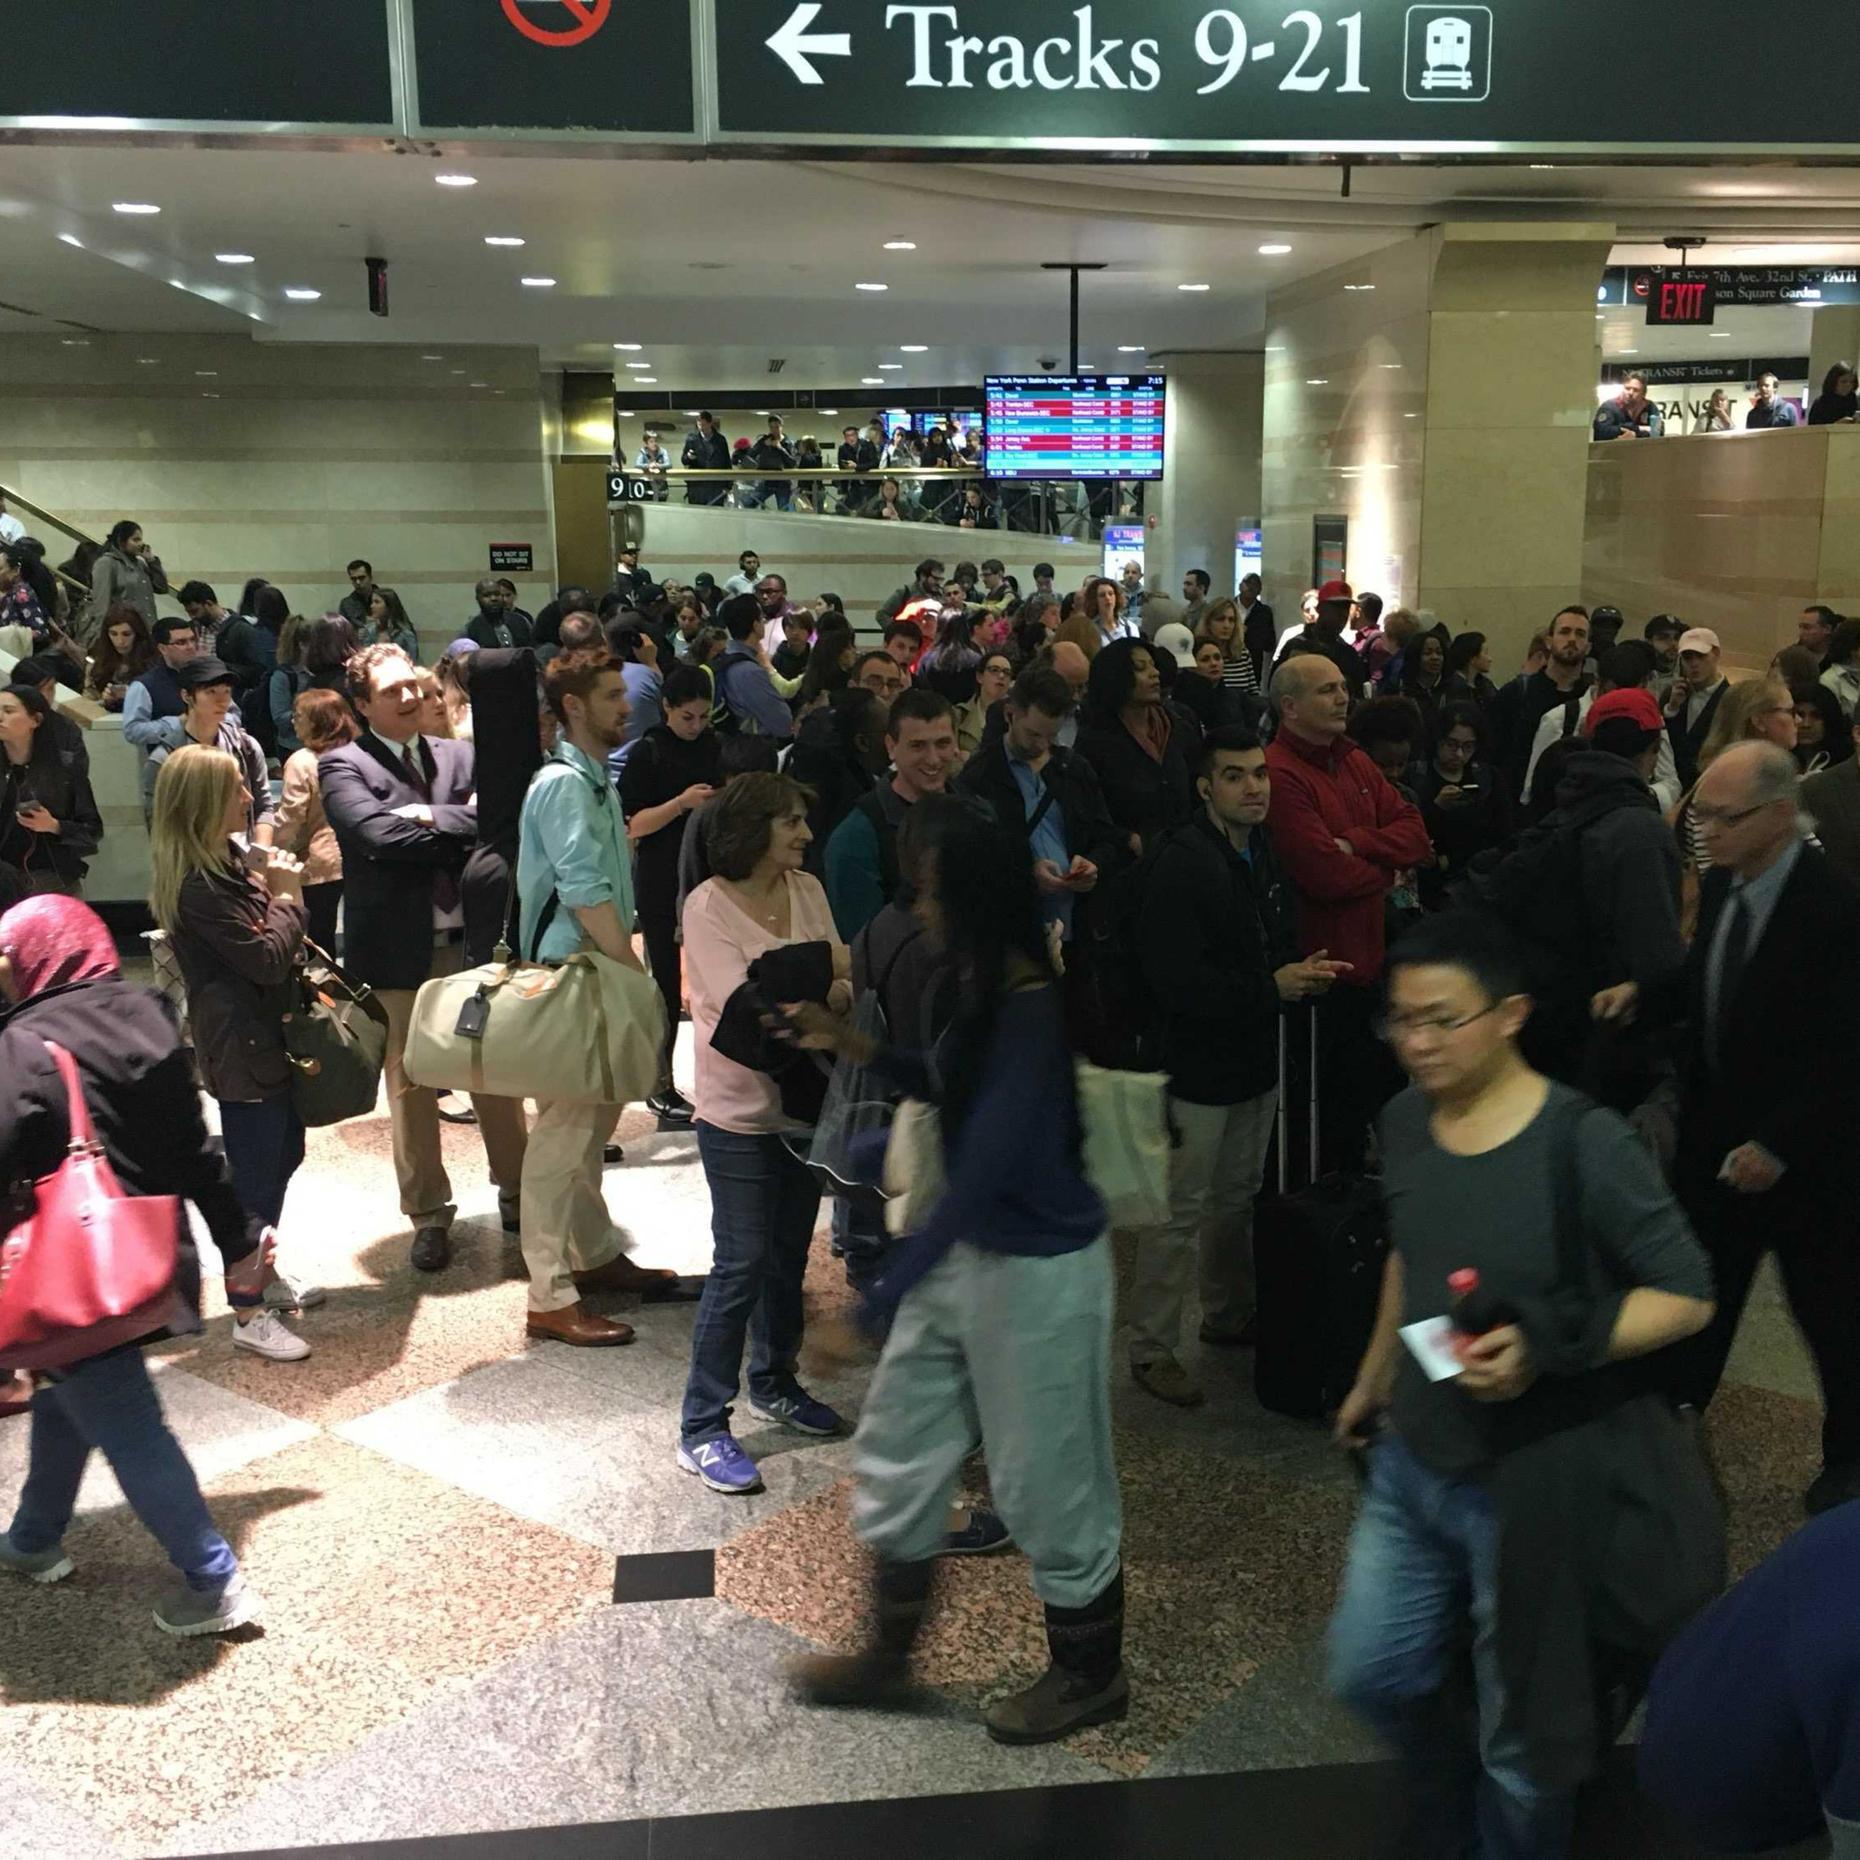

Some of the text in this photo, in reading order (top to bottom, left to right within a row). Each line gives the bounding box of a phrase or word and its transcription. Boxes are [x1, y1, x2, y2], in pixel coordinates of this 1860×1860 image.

[886, 4, 1371, 95] Tracks 9-21
[1713, 271, 1731, 282] 7th
[1736, 271, 1759, 282] Ave.
[1764, 271, 1794, 282] 32nd
[1798, 271, 1812, 282] St.
[1822, 270, 1857, 283] PATH
[1660, 284, 1706, 319] EXIT
[1738, 286, 1776, 301] Square
[1780, 286, 1821, 298] Garden
[1148, 376, 1163, 385] 7:15
[1657, 399, 1737, 419] RANST
[611, 477, 624, 497] 9
[692, 1443, 721, 1468] N
